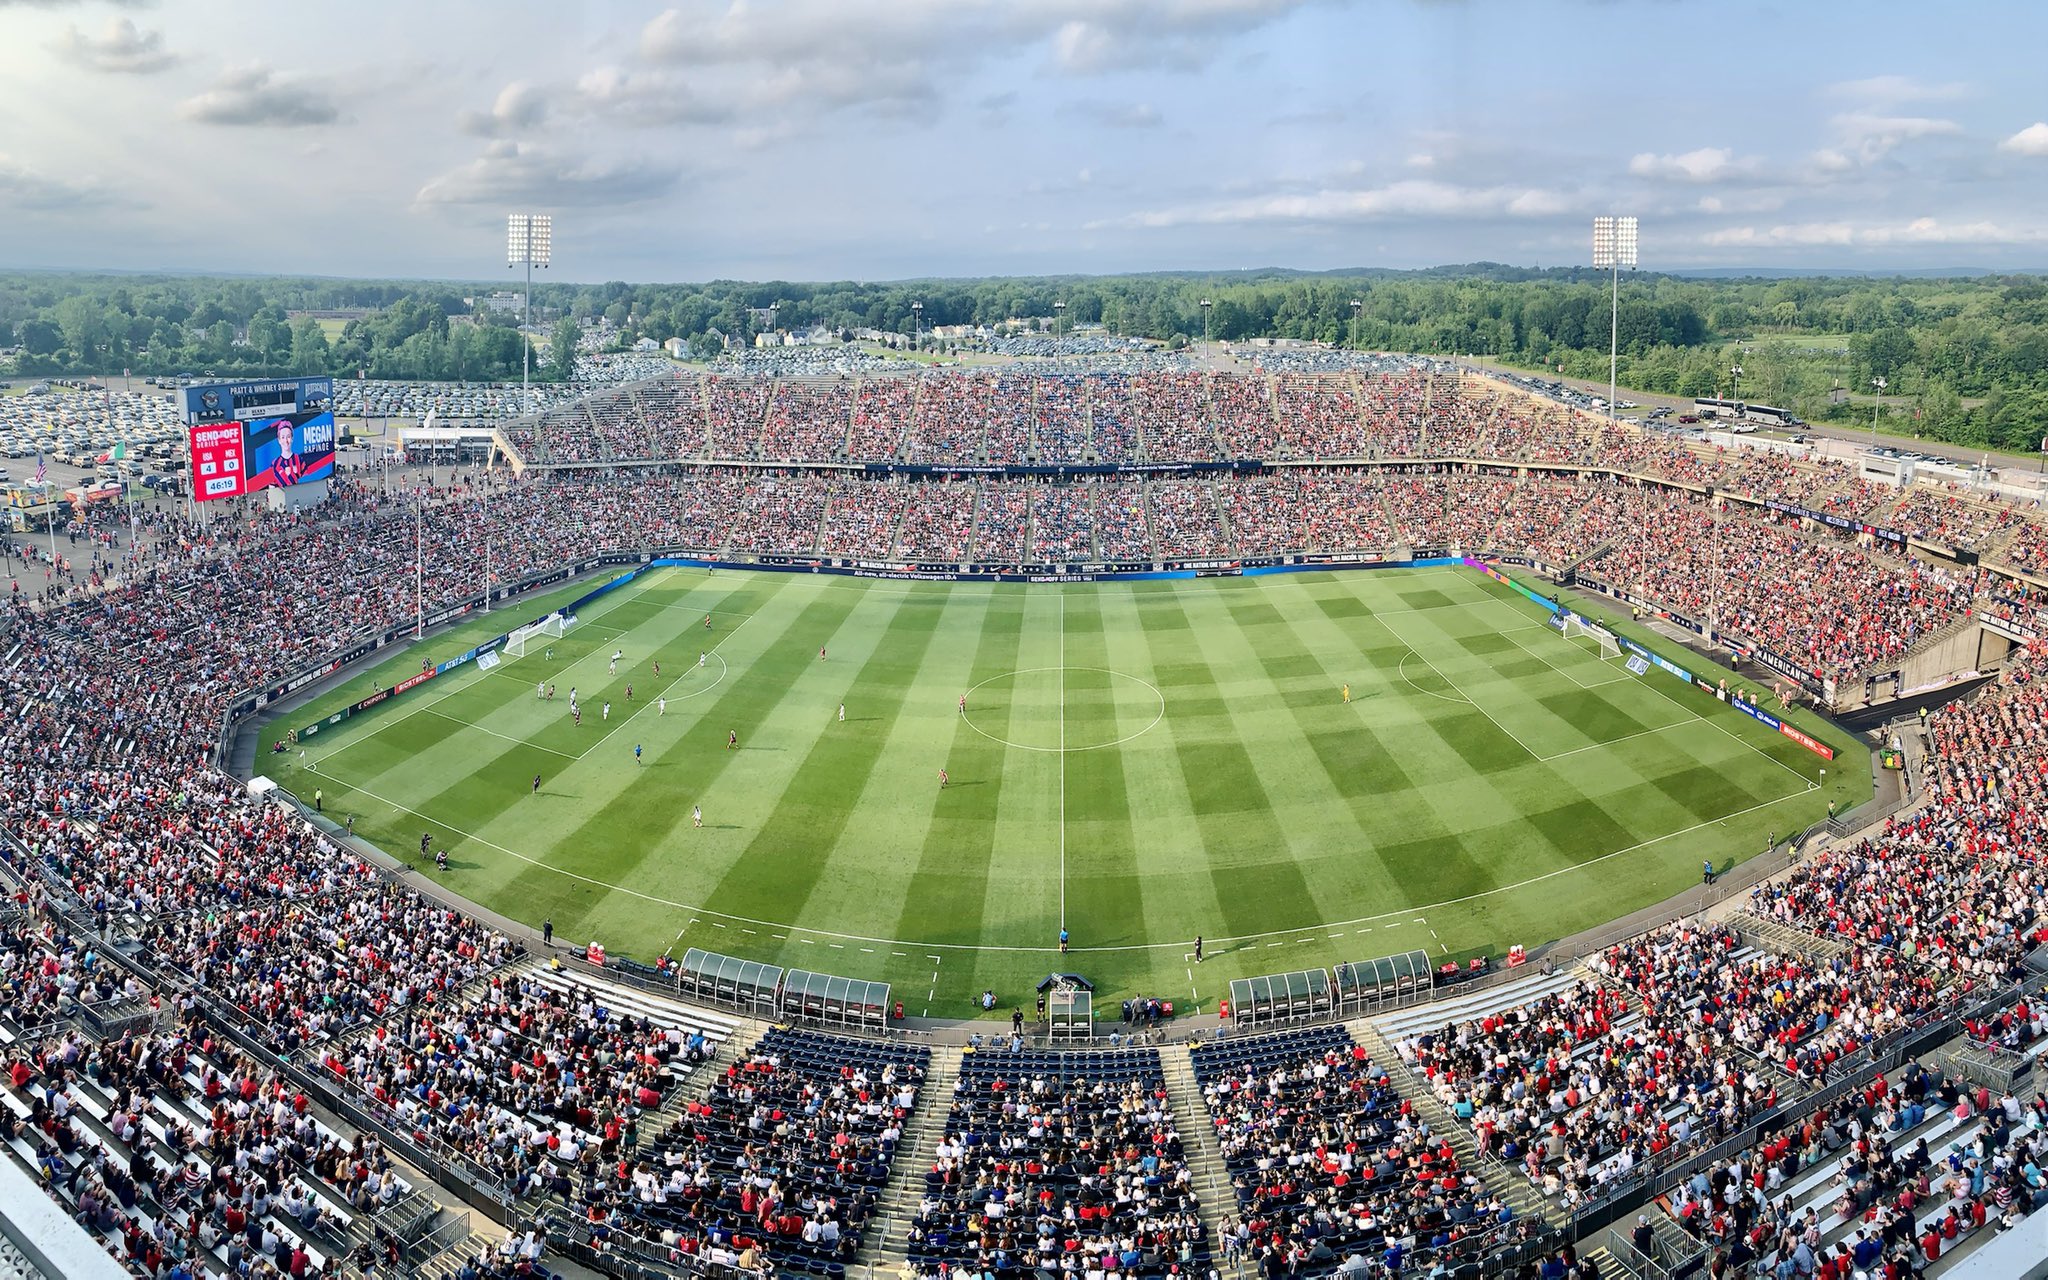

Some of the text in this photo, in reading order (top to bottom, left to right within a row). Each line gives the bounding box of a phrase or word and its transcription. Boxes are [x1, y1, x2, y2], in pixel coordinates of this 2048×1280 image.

[230, 386, 247, 395] PRATT
[254, 384, 277, 392] WHITNEY
[277, 382, 299, 390] STADIUM
[303, 424, 332, 444] MEGAN
[196, 440, 219, 449] SERIES
[303, 443, 329, 454] RAPINOE
[202, 452, 213, 461] USA
[225, 449, 236, 458] MEX
[229, 461, 235, 469] 0
[210, 480, 233, 490] 46:19
[1790, 506, 1810, 517] SERIES
[854, 570, 878, 578] All-new,
[879, 571, 909, 579] all-electric
[479, 639, 501, 653] Volkswagen
[444, 653, 468, 671] AT&T 5G
[1763, 652, 1801, 680] AMERICAN
[398, 674, 427, 691] BIOSTEEL
[363, 692, 388, 707] CHIPOTLE
[1784, 726, 1819, 751] BIOSTEEL
